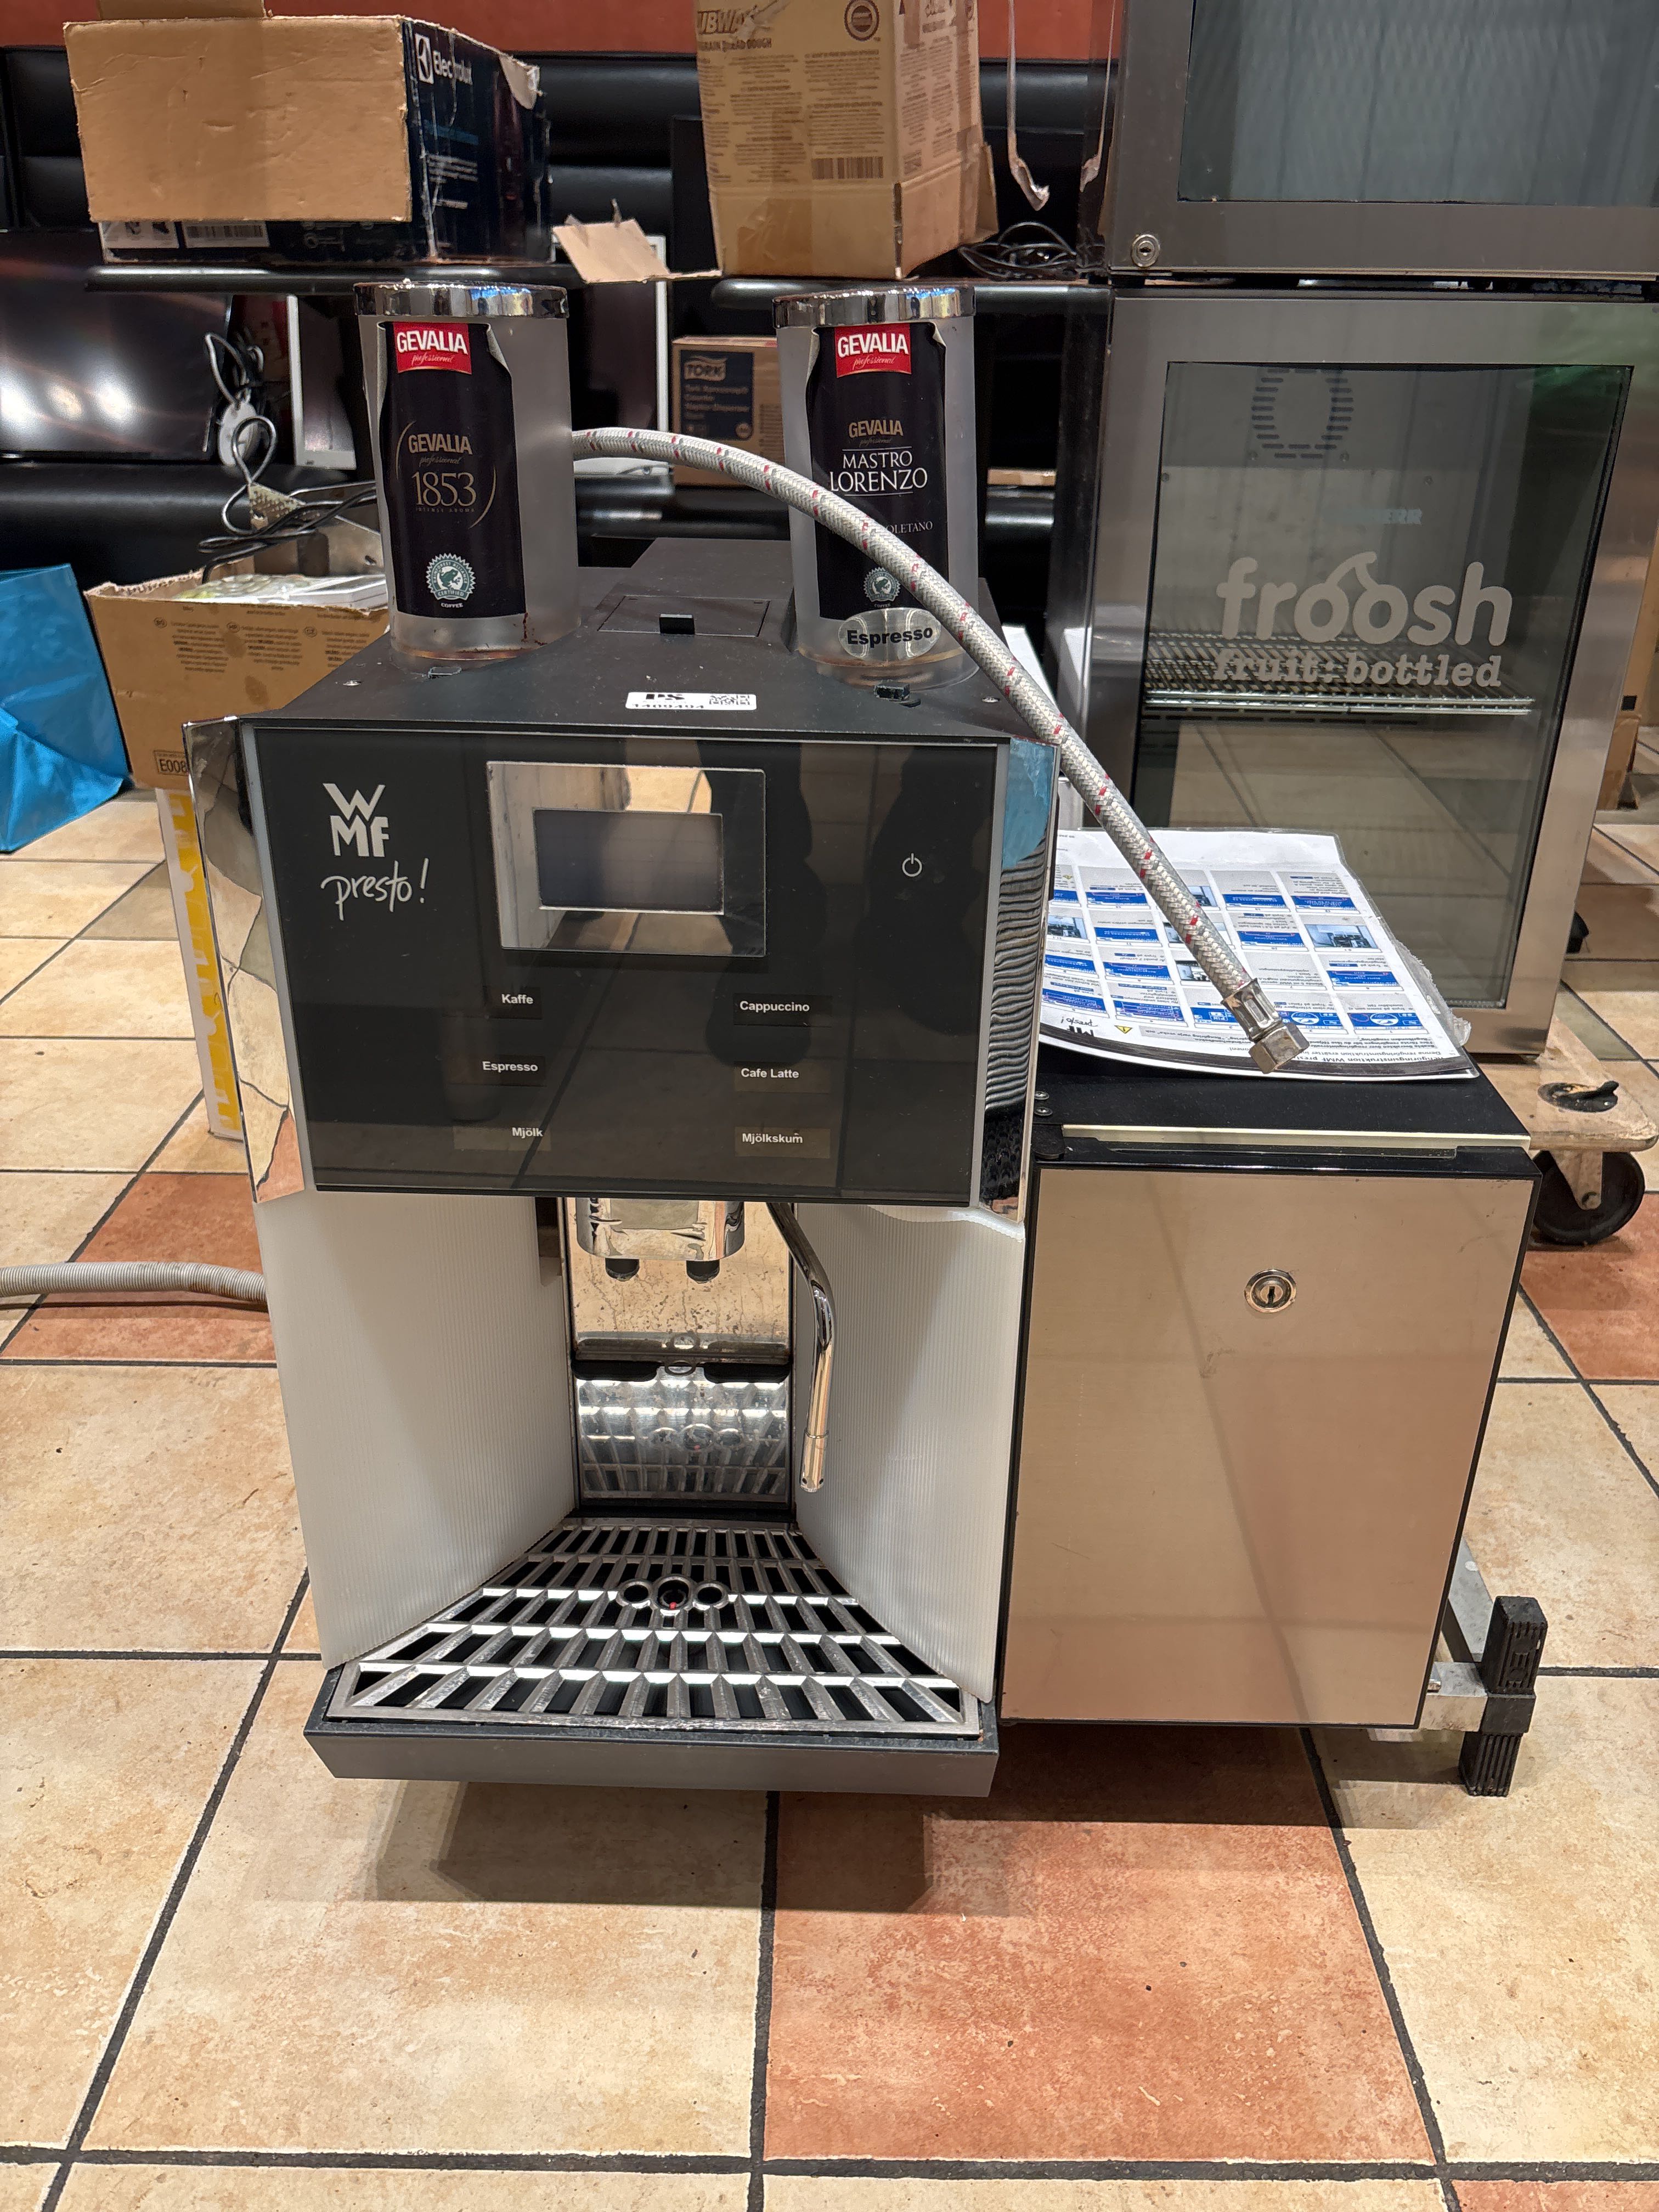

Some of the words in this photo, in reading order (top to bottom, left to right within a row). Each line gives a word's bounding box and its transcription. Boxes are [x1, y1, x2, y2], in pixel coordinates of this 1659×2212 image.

[397, 330, 469, 356] GEVALIA
[838, 333, 909, 358] GEVALIA
[852, 355, 896, 371] professional
[849, 420, 904, 438] GEVALIA
[408, 433, 472, 455] GEVALIA
[843, 451, 913, 469] MASTRO
[412, 471, 476, 506] 1853
[830, 467, 928, 492] LORENZO
[886, 521, 933, 534] OLETANO
[1216, 551, 1513, 646] froosh
[847, 627, 933, 648] Espresso
[323, 783, 390, 857] WMF
[501, 994, 534, 1005] Kaffe
[740, 1001, 810, 1013] Cappuccino
[482, 1062, 538, 1074] Espresso
[741, 1068, 767, 1078] Cafe
[770, 1069, 799, 1079] Latte
[512, 1126, 543, 1139] Mjölk
[742, 1132, 803, 1145] Mjölkskum
